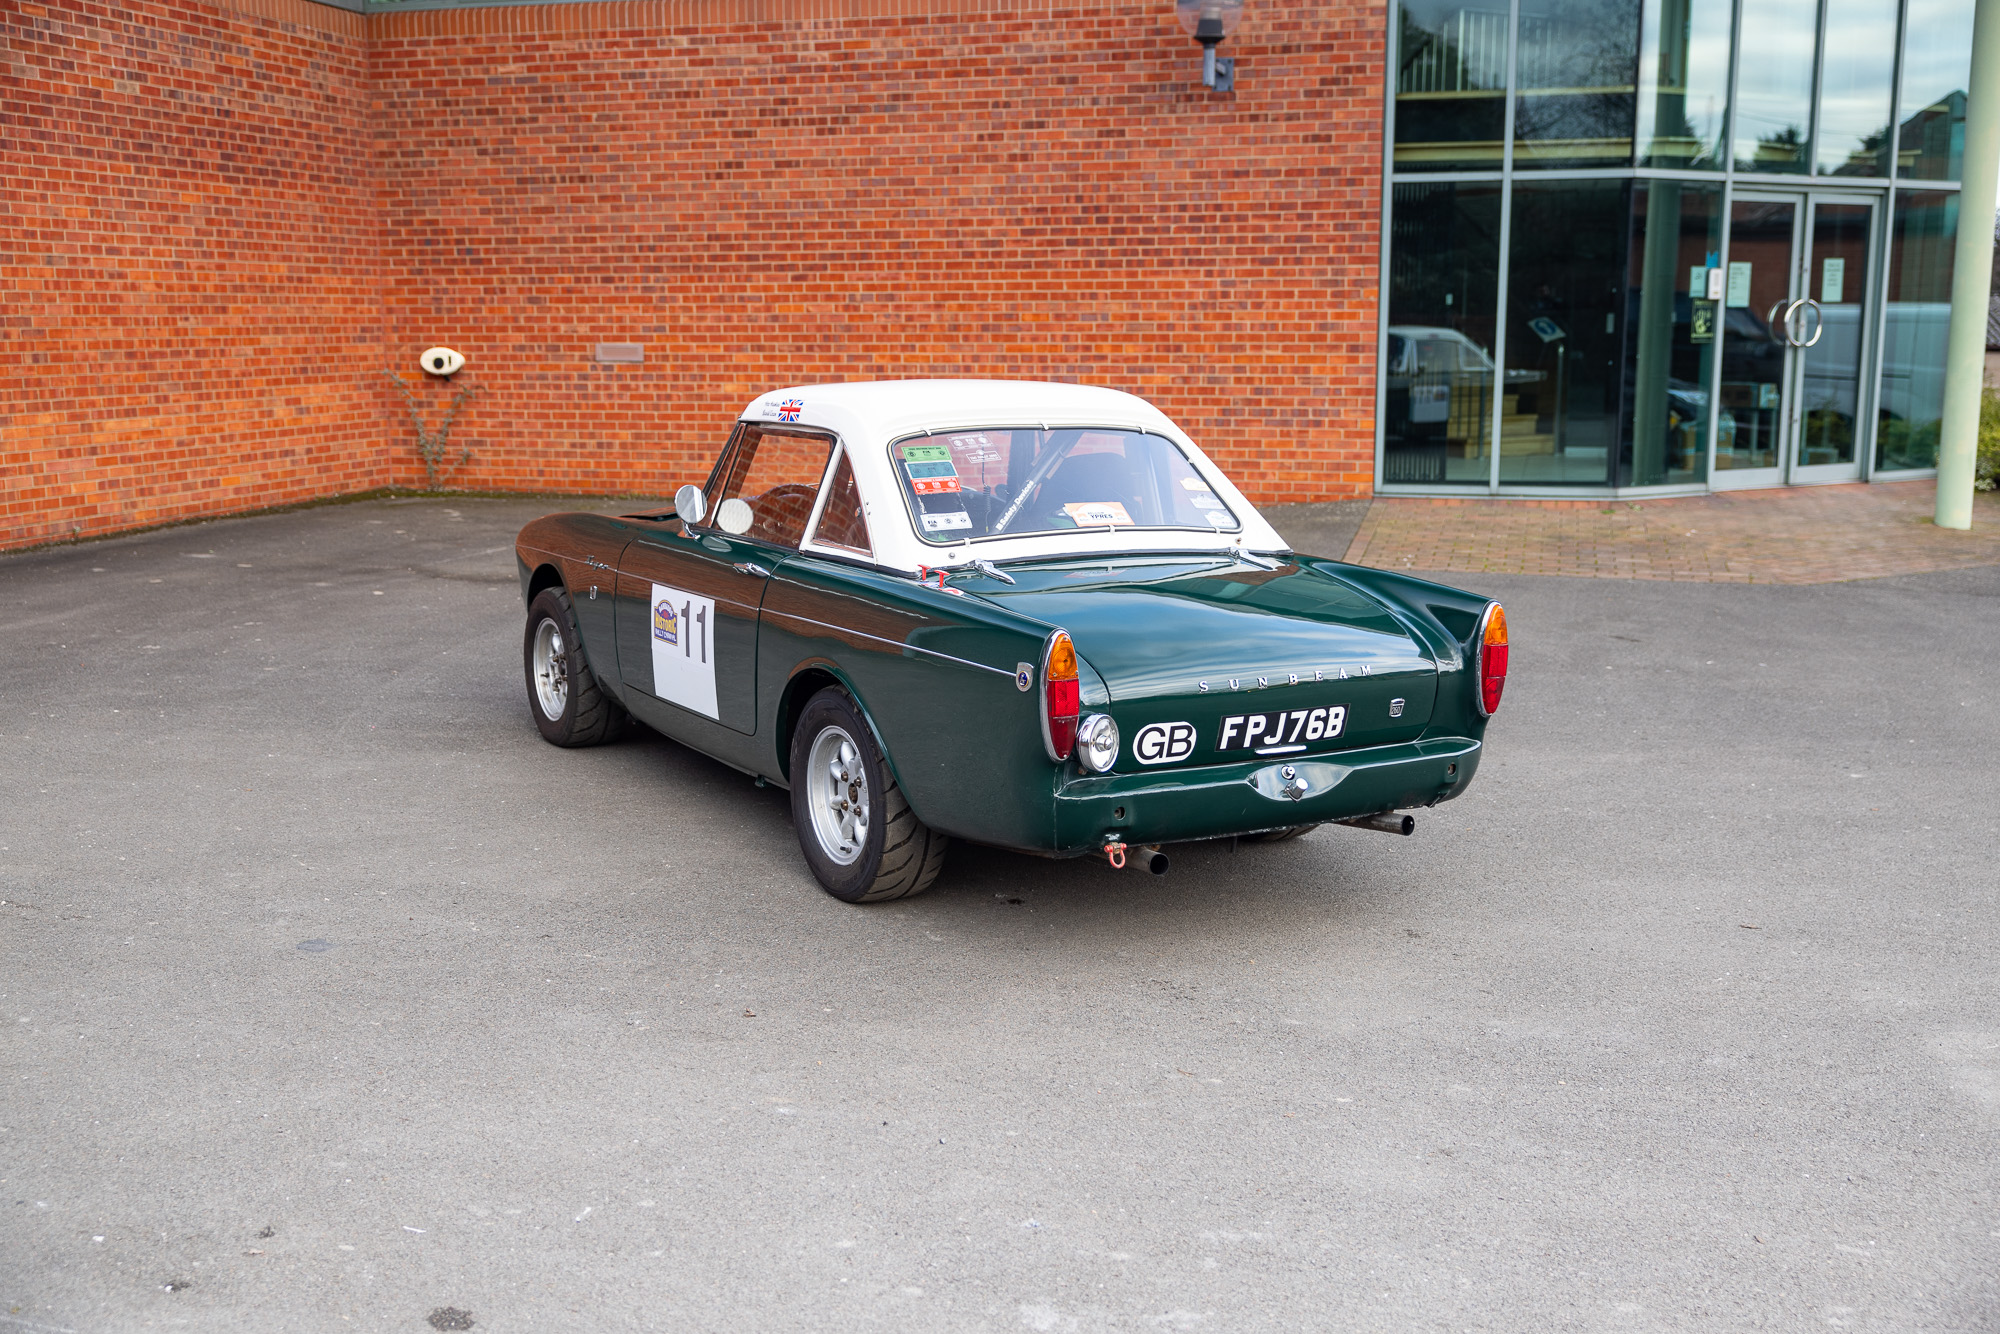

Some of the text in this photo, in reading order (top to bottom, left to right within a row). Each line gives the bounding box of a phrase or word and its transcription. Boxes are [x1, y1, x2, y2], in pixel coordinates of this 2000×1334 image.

[1000, 480, 1034, 526] Safety Devices
[681, 600, 707, 663] 11
[1199, 665, 1372, 692] SUNBEAM
[1137, 724, 1194, 761] GB
[1219, 706, 1346, 750] FPJ76B
